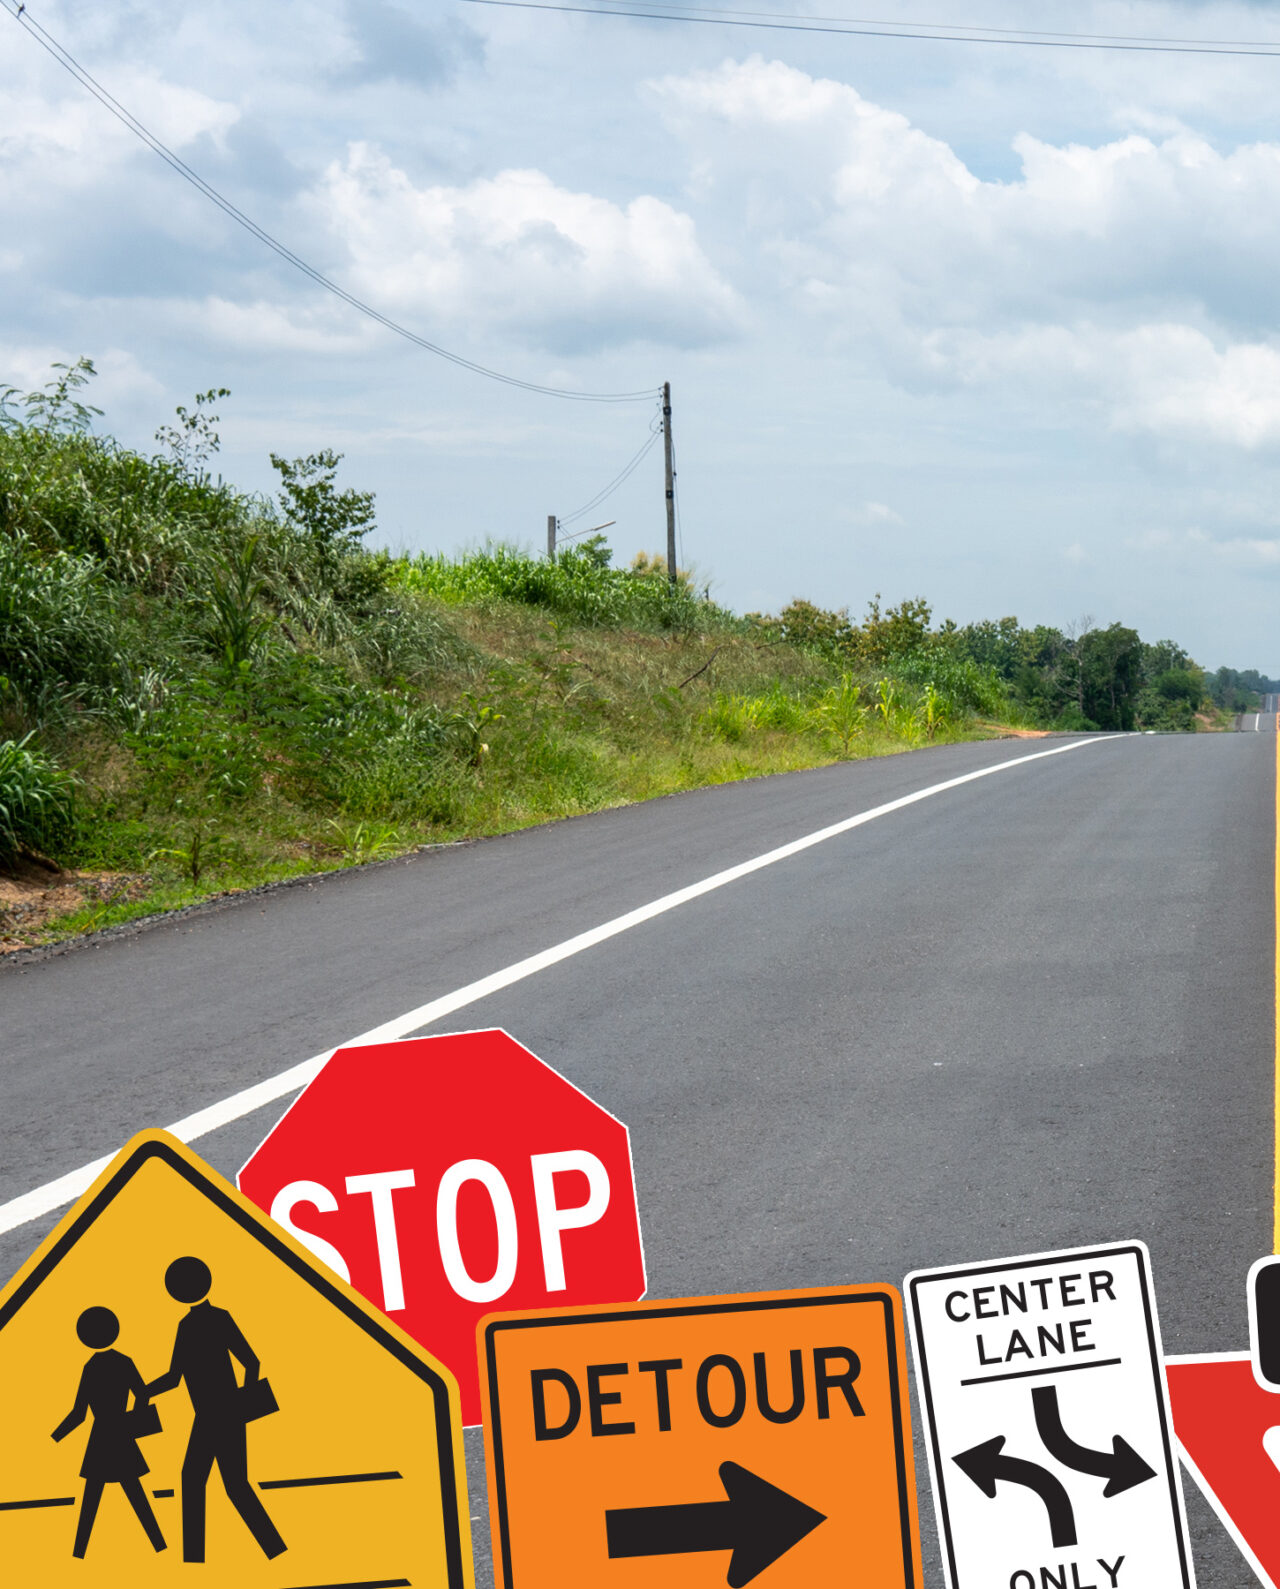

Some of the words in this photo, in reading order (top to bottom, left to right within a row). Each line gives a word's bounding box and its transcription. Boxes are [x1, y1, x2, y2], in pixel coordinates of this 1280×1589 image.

[270, 1149, 611, 1312] STOP
[945, 1270, 1117, 1323] CENTER
[976, 1318, 1096, 1366] LANE
[530, 1346, 866, 1442] DETOUR
[1009, 1555, 1125, 1589] ONLY
